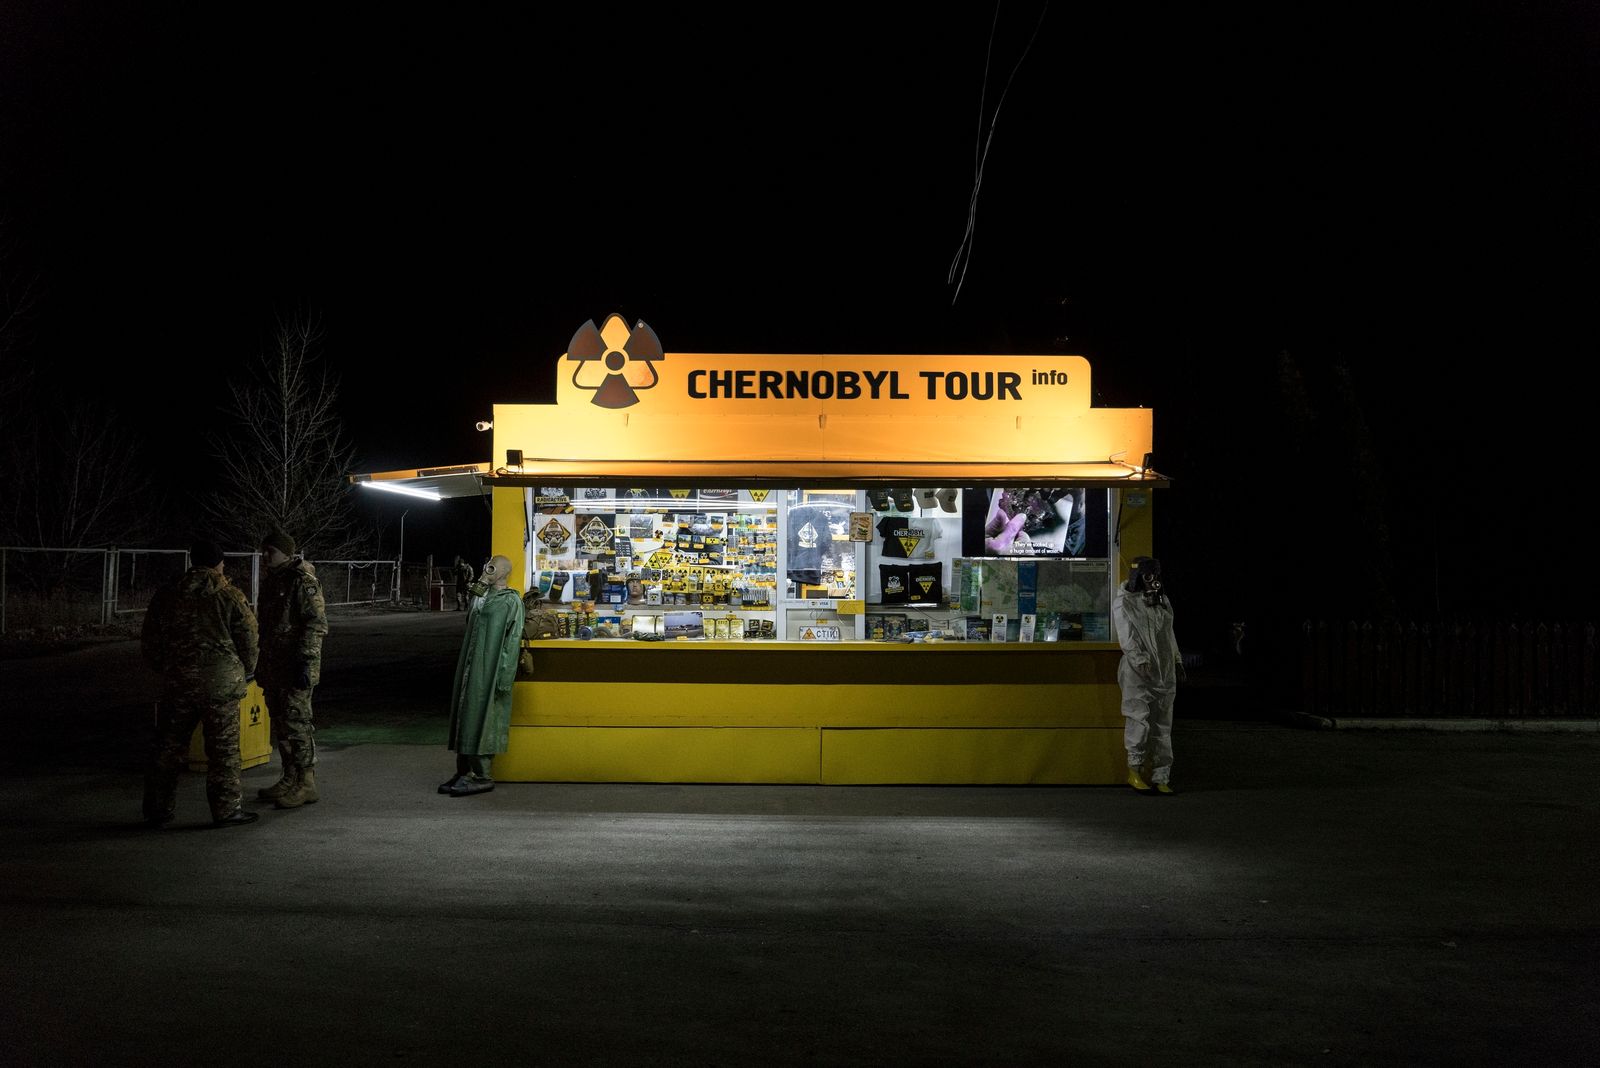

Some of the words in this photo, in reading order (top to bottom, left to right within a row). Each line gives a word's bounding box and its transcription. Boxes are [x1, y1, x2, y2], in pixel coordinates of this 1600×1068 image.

[688, 370, 909, 400] CHERNOBYL
[919, 371, 1022, 401] TOUR
[1032, 369, 1068, 385] info
